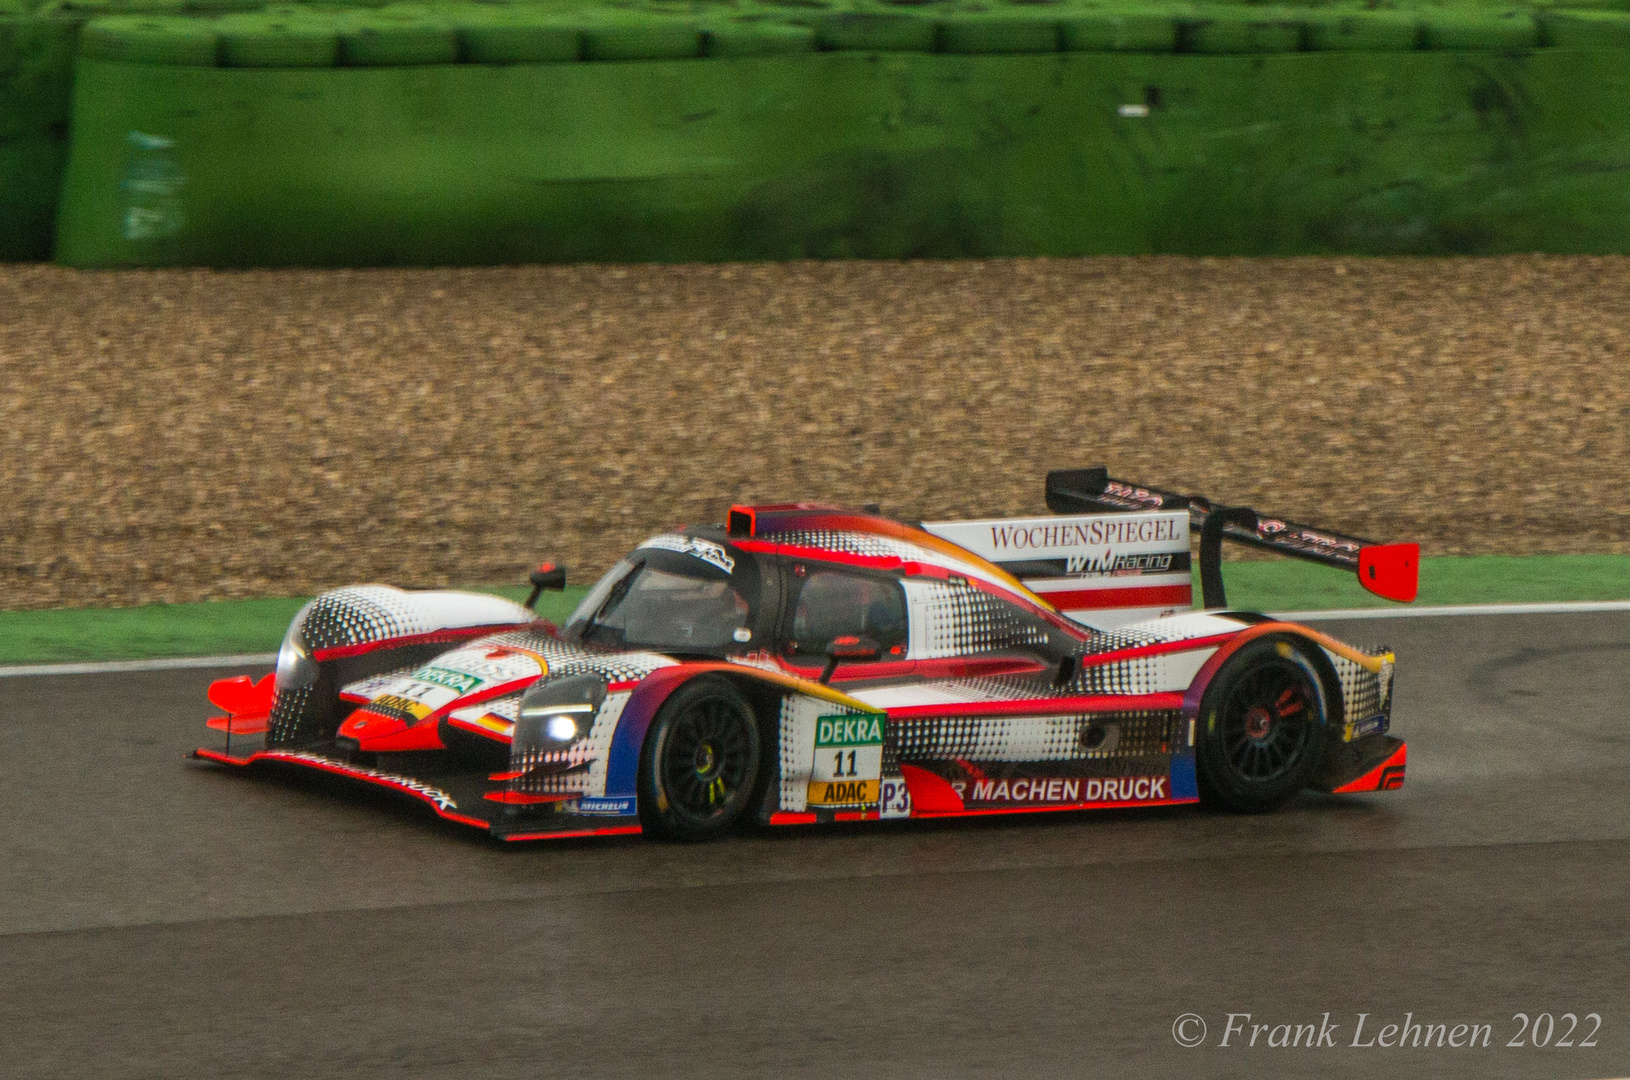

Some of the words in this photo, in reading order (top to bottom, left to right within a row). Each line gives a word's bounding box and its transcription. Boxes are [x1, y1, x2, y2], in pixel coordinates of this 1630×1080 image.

[991, 518, 1180, 549] WOCHENSPIEGEL
[400, 682, 436, 699] 11
[416, 668, 473, 693] DEKRA
[819, 717, 882, 743] DEKRA
[832, 749, 858, 778] 11
[823, 782, 868, 803] ADAC
[881, 782, 910, 814] P3
[972, 778, 1080, 801] MACHEN
[1086, 777, 1167, 800] DRUCK
[580, 801, 630, 812] MICHELIN
